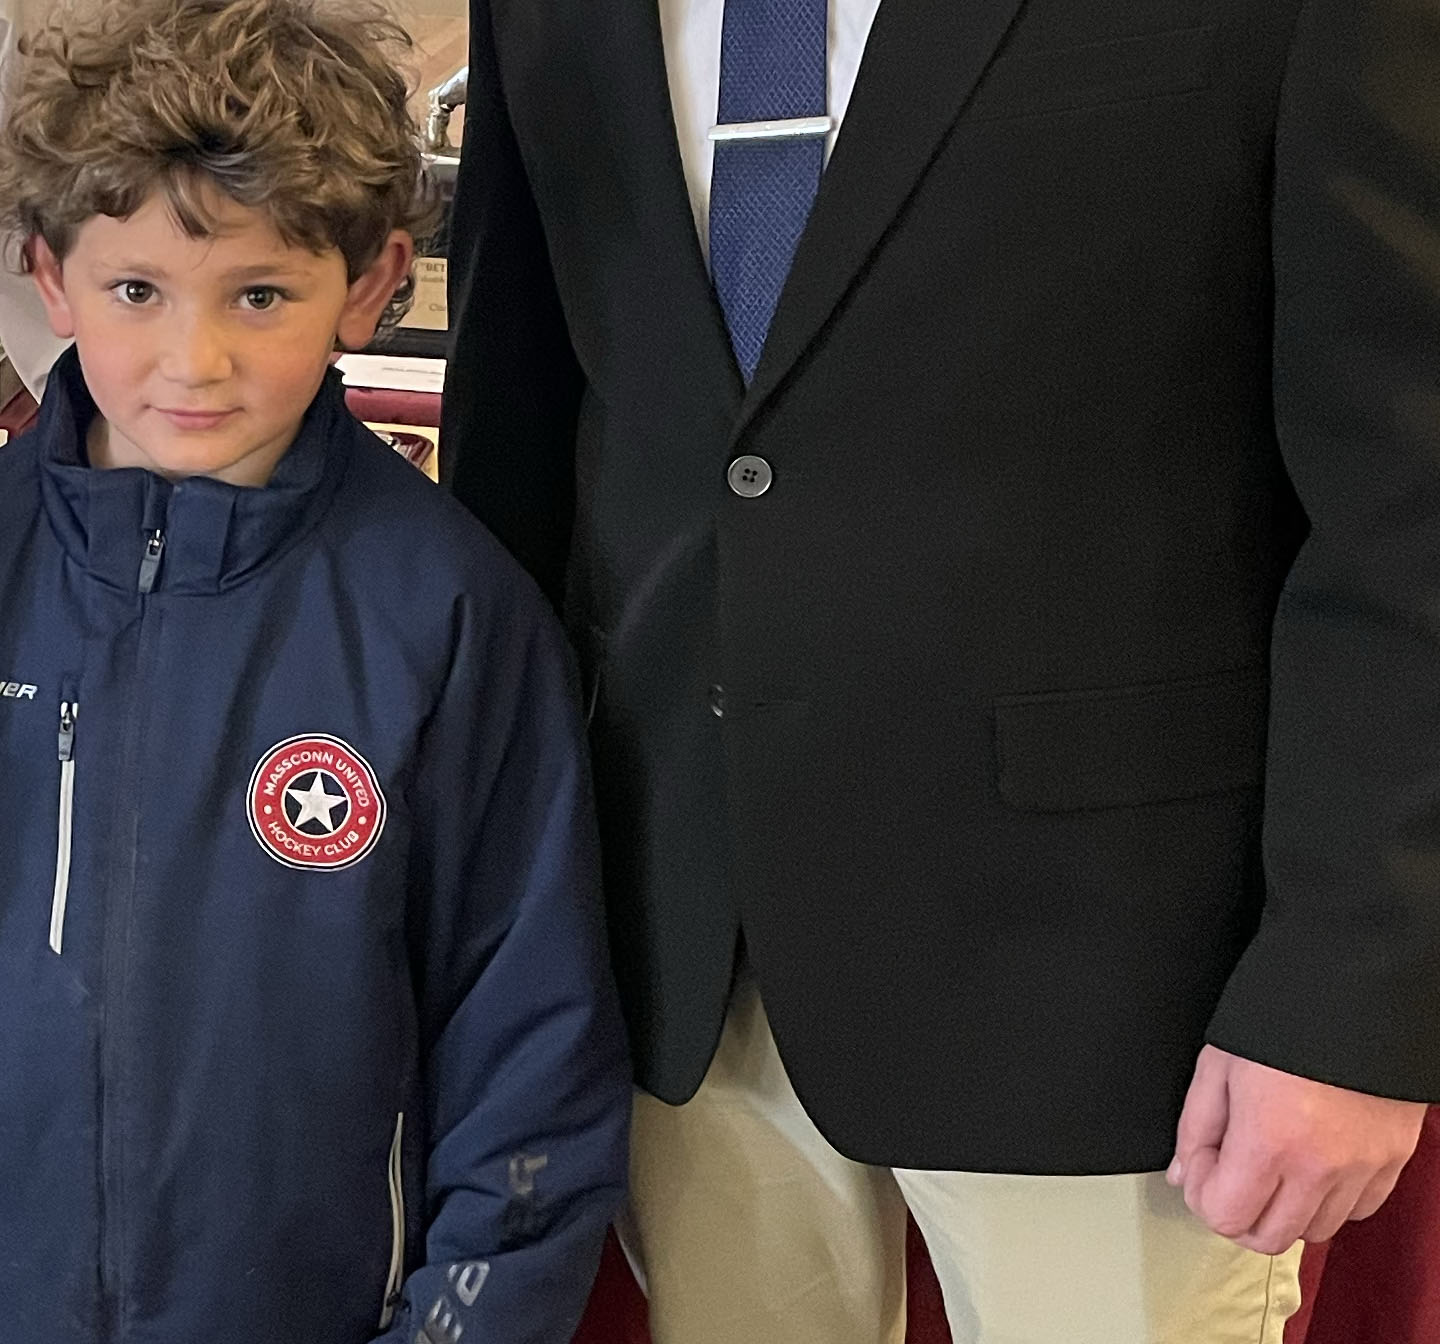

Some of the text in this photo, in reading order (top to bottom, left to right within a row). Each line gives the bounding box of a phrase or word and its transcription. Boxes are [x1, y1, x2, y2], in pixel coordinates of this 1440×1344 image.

[263, 751, 370, 808] MASSCONN UNITED
[268, 821, 360, 857] HOCKEY CLUB
